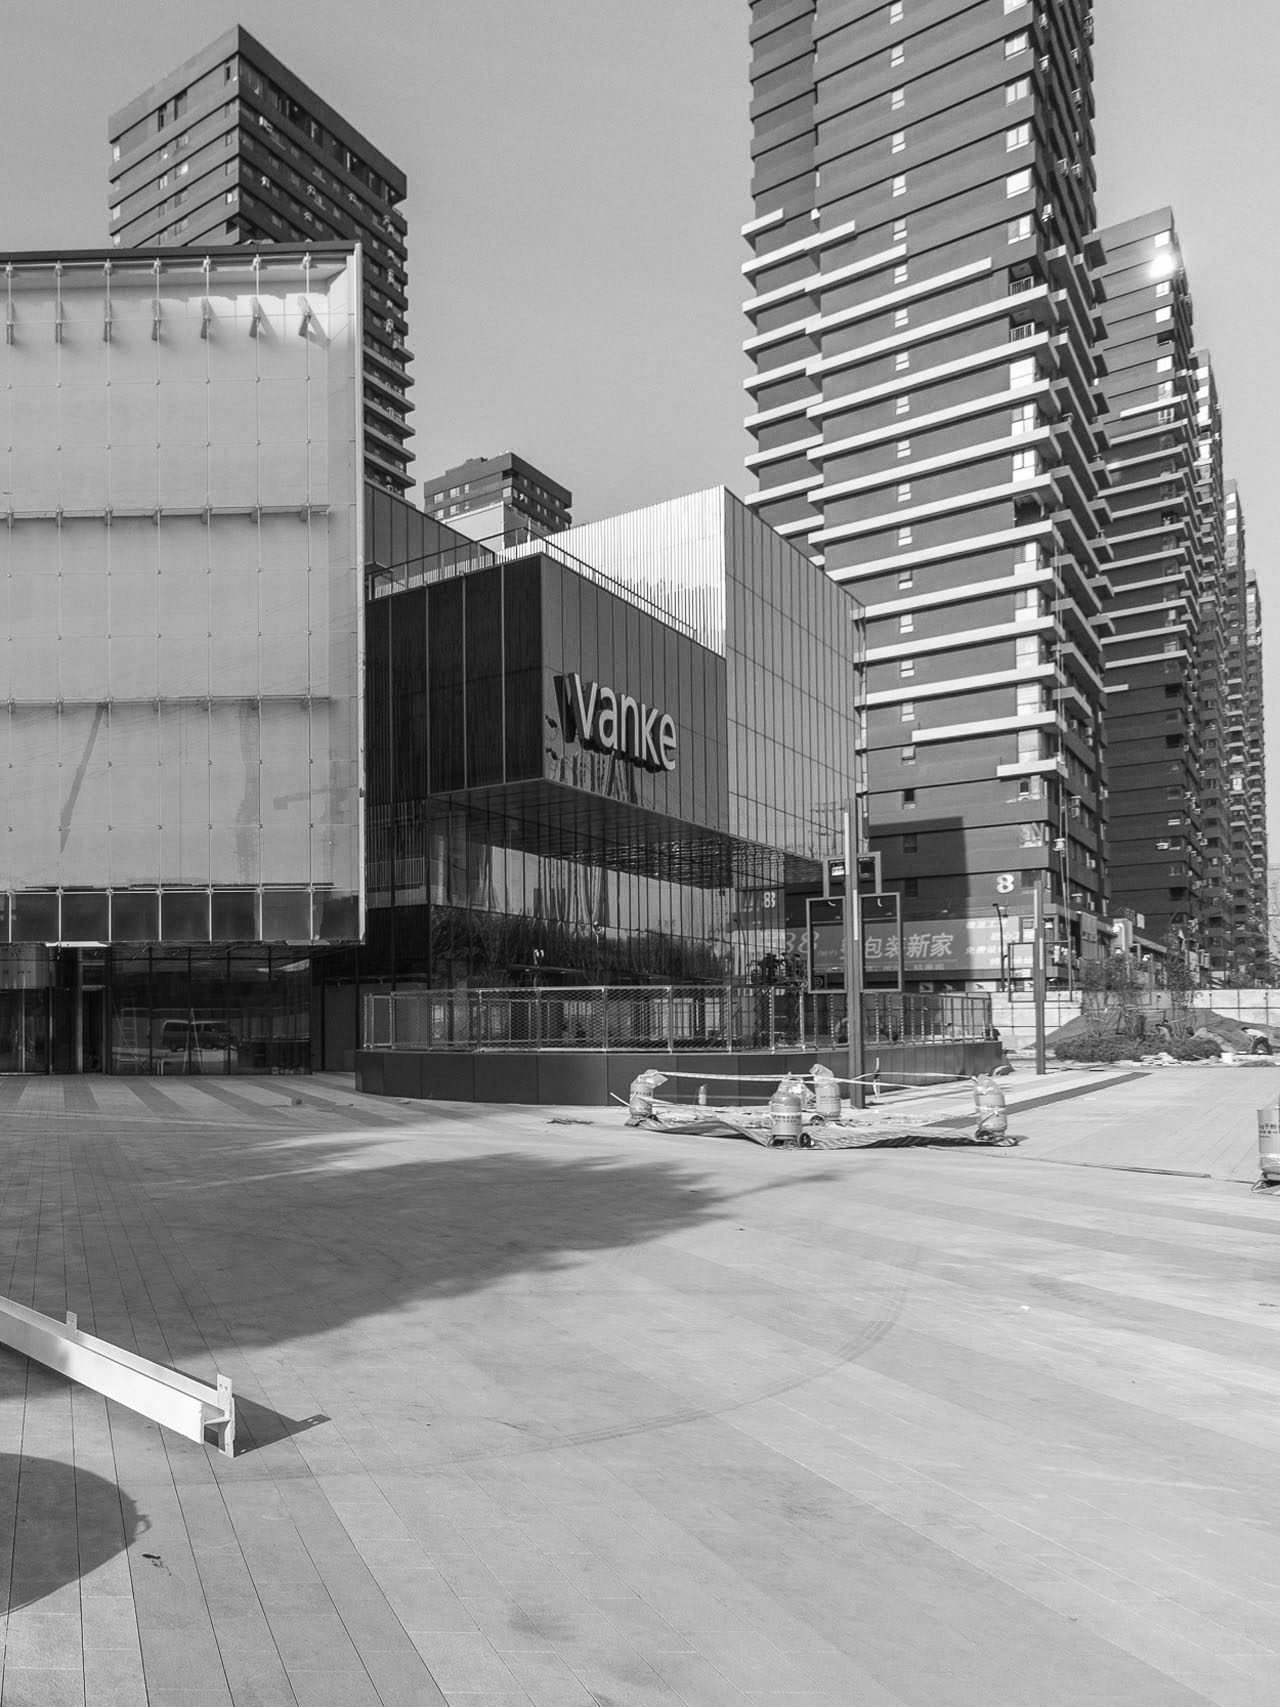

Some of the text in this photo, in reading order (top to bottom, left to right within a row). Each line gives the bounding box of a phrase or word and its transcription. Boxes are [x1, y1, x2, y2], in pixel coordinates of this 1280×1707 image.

[996, 873, 1016, 894] 8
[838, 932, 954, 960] 包装新家
